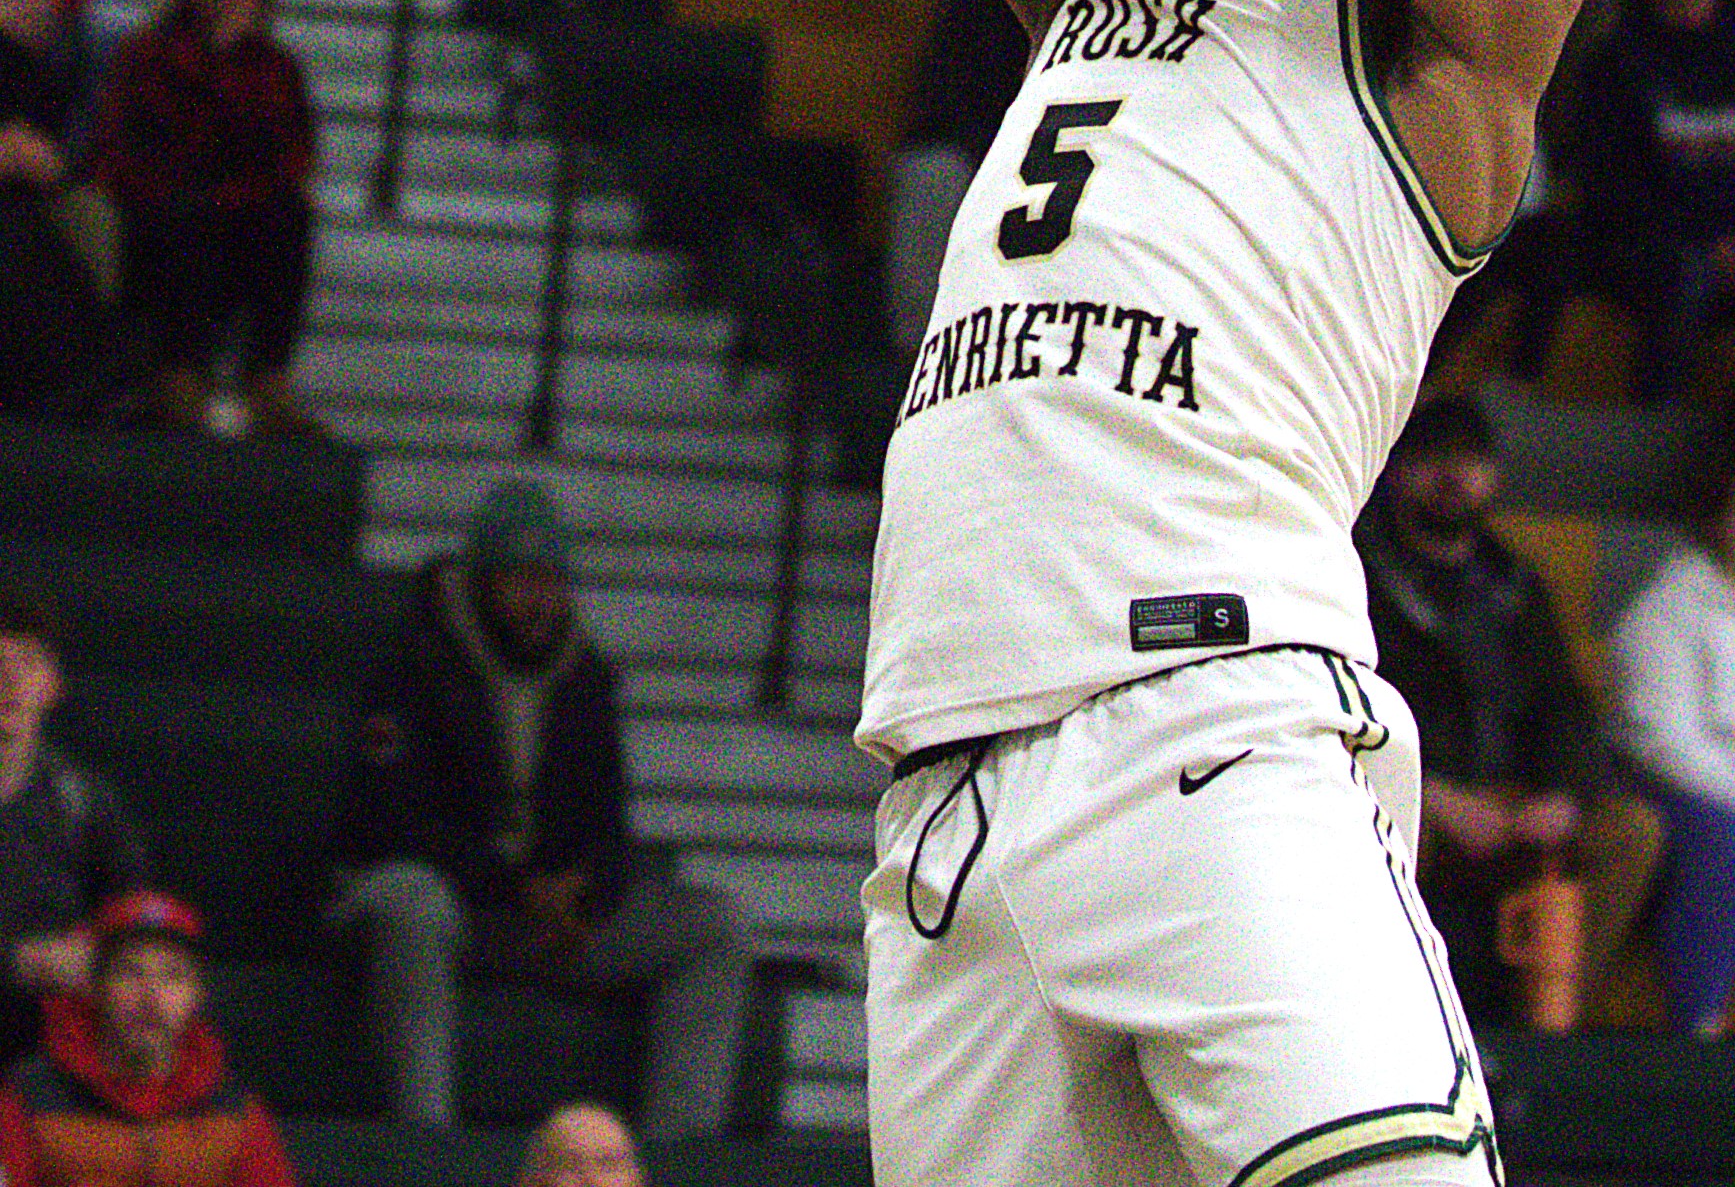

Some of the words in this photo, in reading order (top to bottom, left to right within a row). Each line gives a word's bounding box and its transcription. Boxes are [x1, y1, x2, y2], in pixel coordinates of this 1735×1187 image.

[996, 95, 1130, 264] 5
[896, 301, 1199, 428] ENRIETTA
[1214, 608, 1230, 628] S
